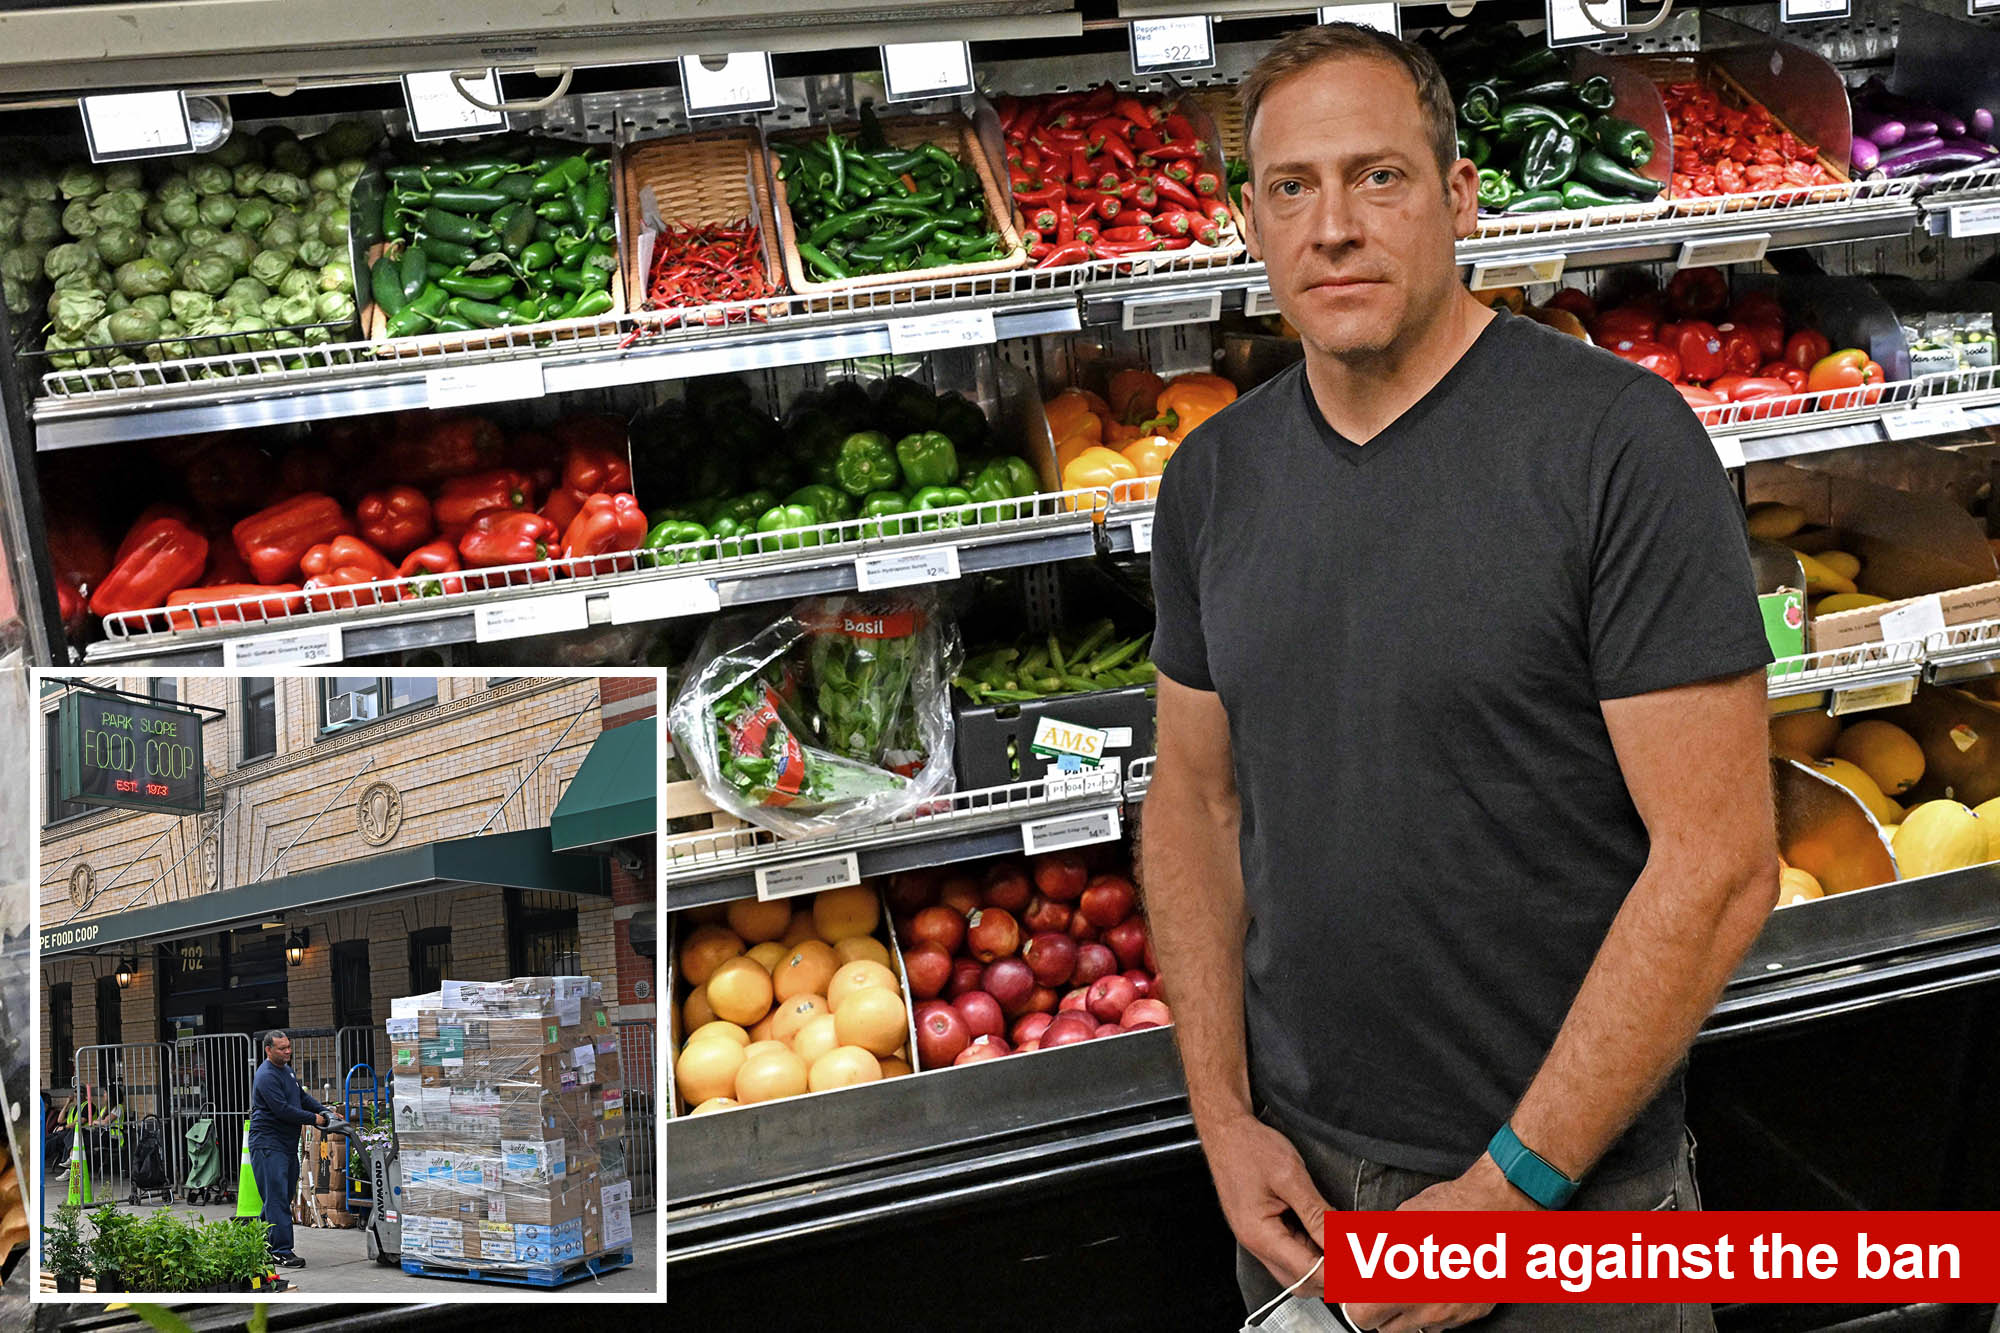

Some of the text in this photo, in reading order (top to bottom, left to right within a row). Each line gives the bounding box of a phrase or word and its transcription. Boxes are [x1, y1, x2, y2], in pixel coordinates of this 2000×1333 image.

[844, 618, 884, 635] Basil
[102, 712, 177, 737] PARK SLOPE
[1041, 727, 1098, 753] AMS
[86, 729, 194, 779] FOOD COOP
[146, 784, 169, 796] 1973
[52, 930, 73, 947] FOOD
[75, 925, 99, 941] COOP
[181, 945, 203, 972] 702
[375, 1160, 385, 1222] RAYMOND
